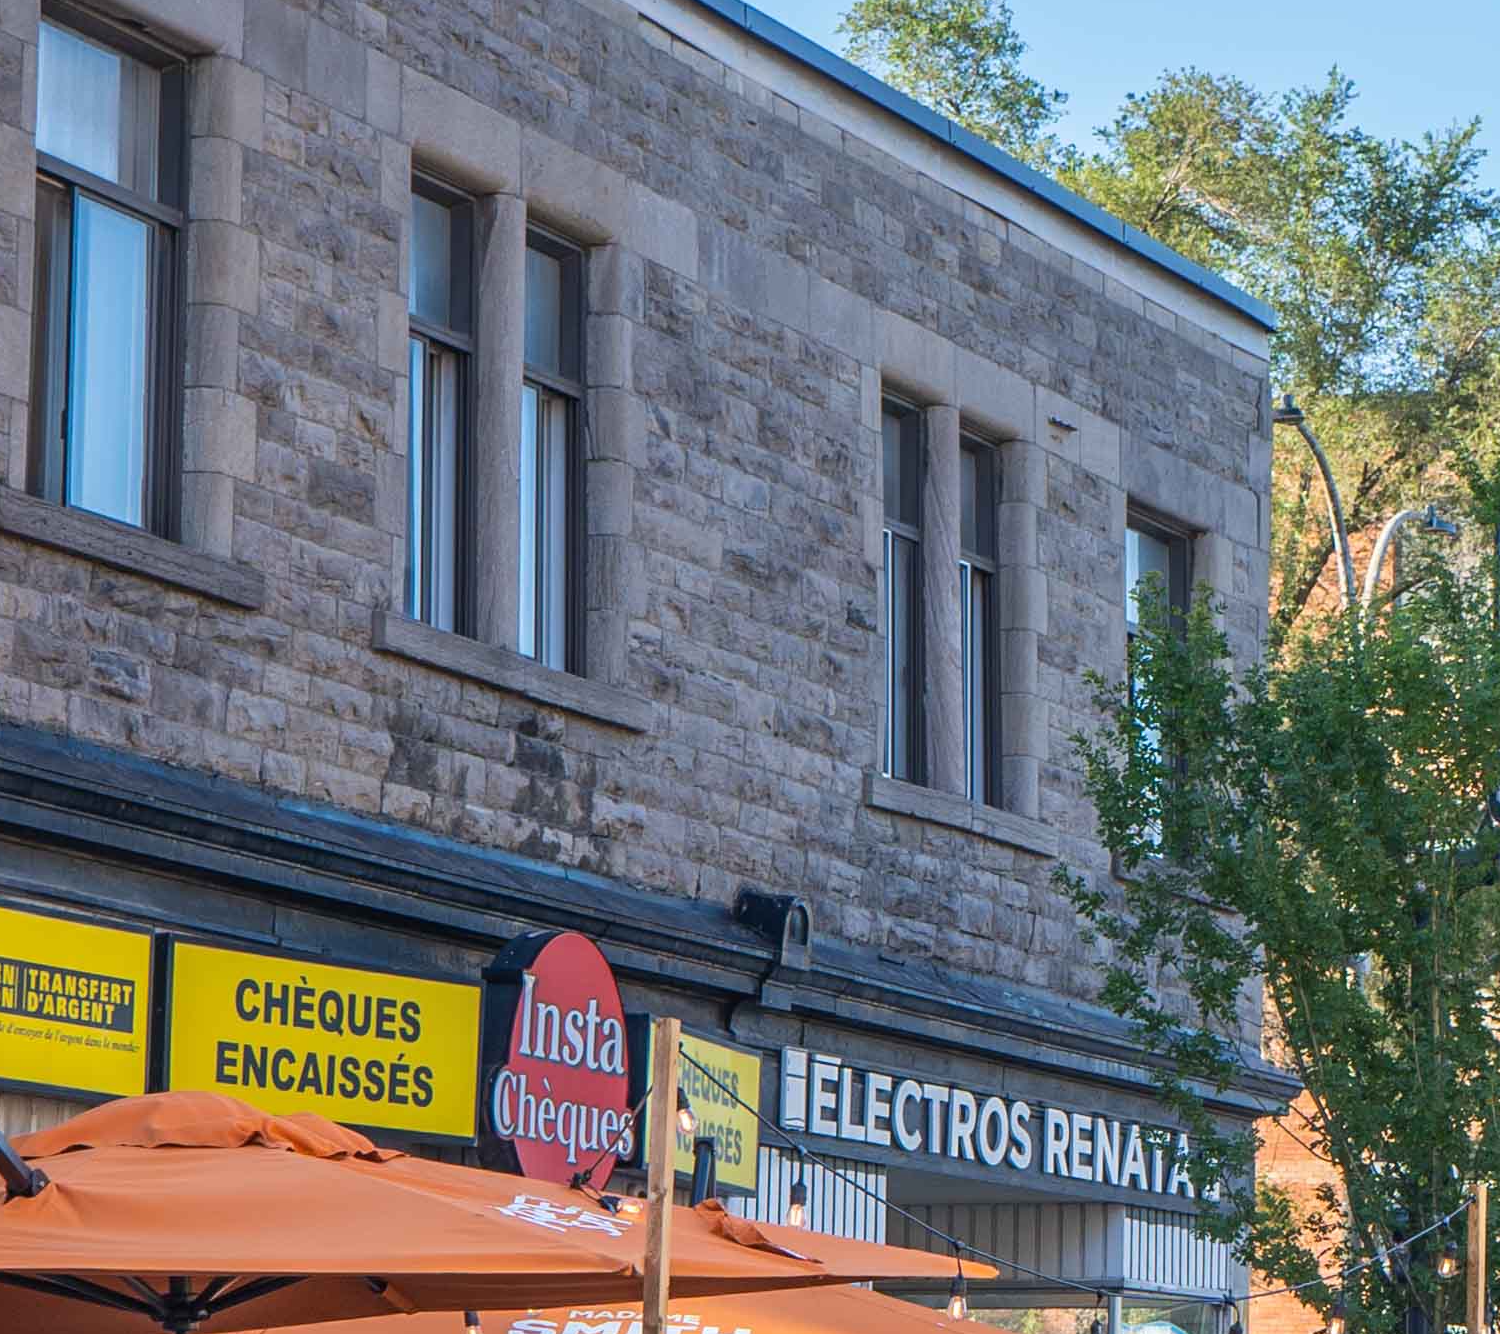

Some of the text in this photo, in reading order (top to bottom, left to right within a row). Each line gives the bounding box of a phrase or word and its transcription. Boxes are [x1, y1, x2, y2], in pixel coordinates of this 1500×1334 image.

[27, 991, 115, 1025] D'ARGENT
[28, 969, 132, 1006] TRANSFERT
[235, 975, 421, 1043] CHÈQUES
[518, 969, 626, 1075] Insta
[215, 1040, 434, 1108] ENCAISSÉS
[492, 1066, 638, 1165] Chèques
[810, 1053, 1032, 1170] ELECTROS
